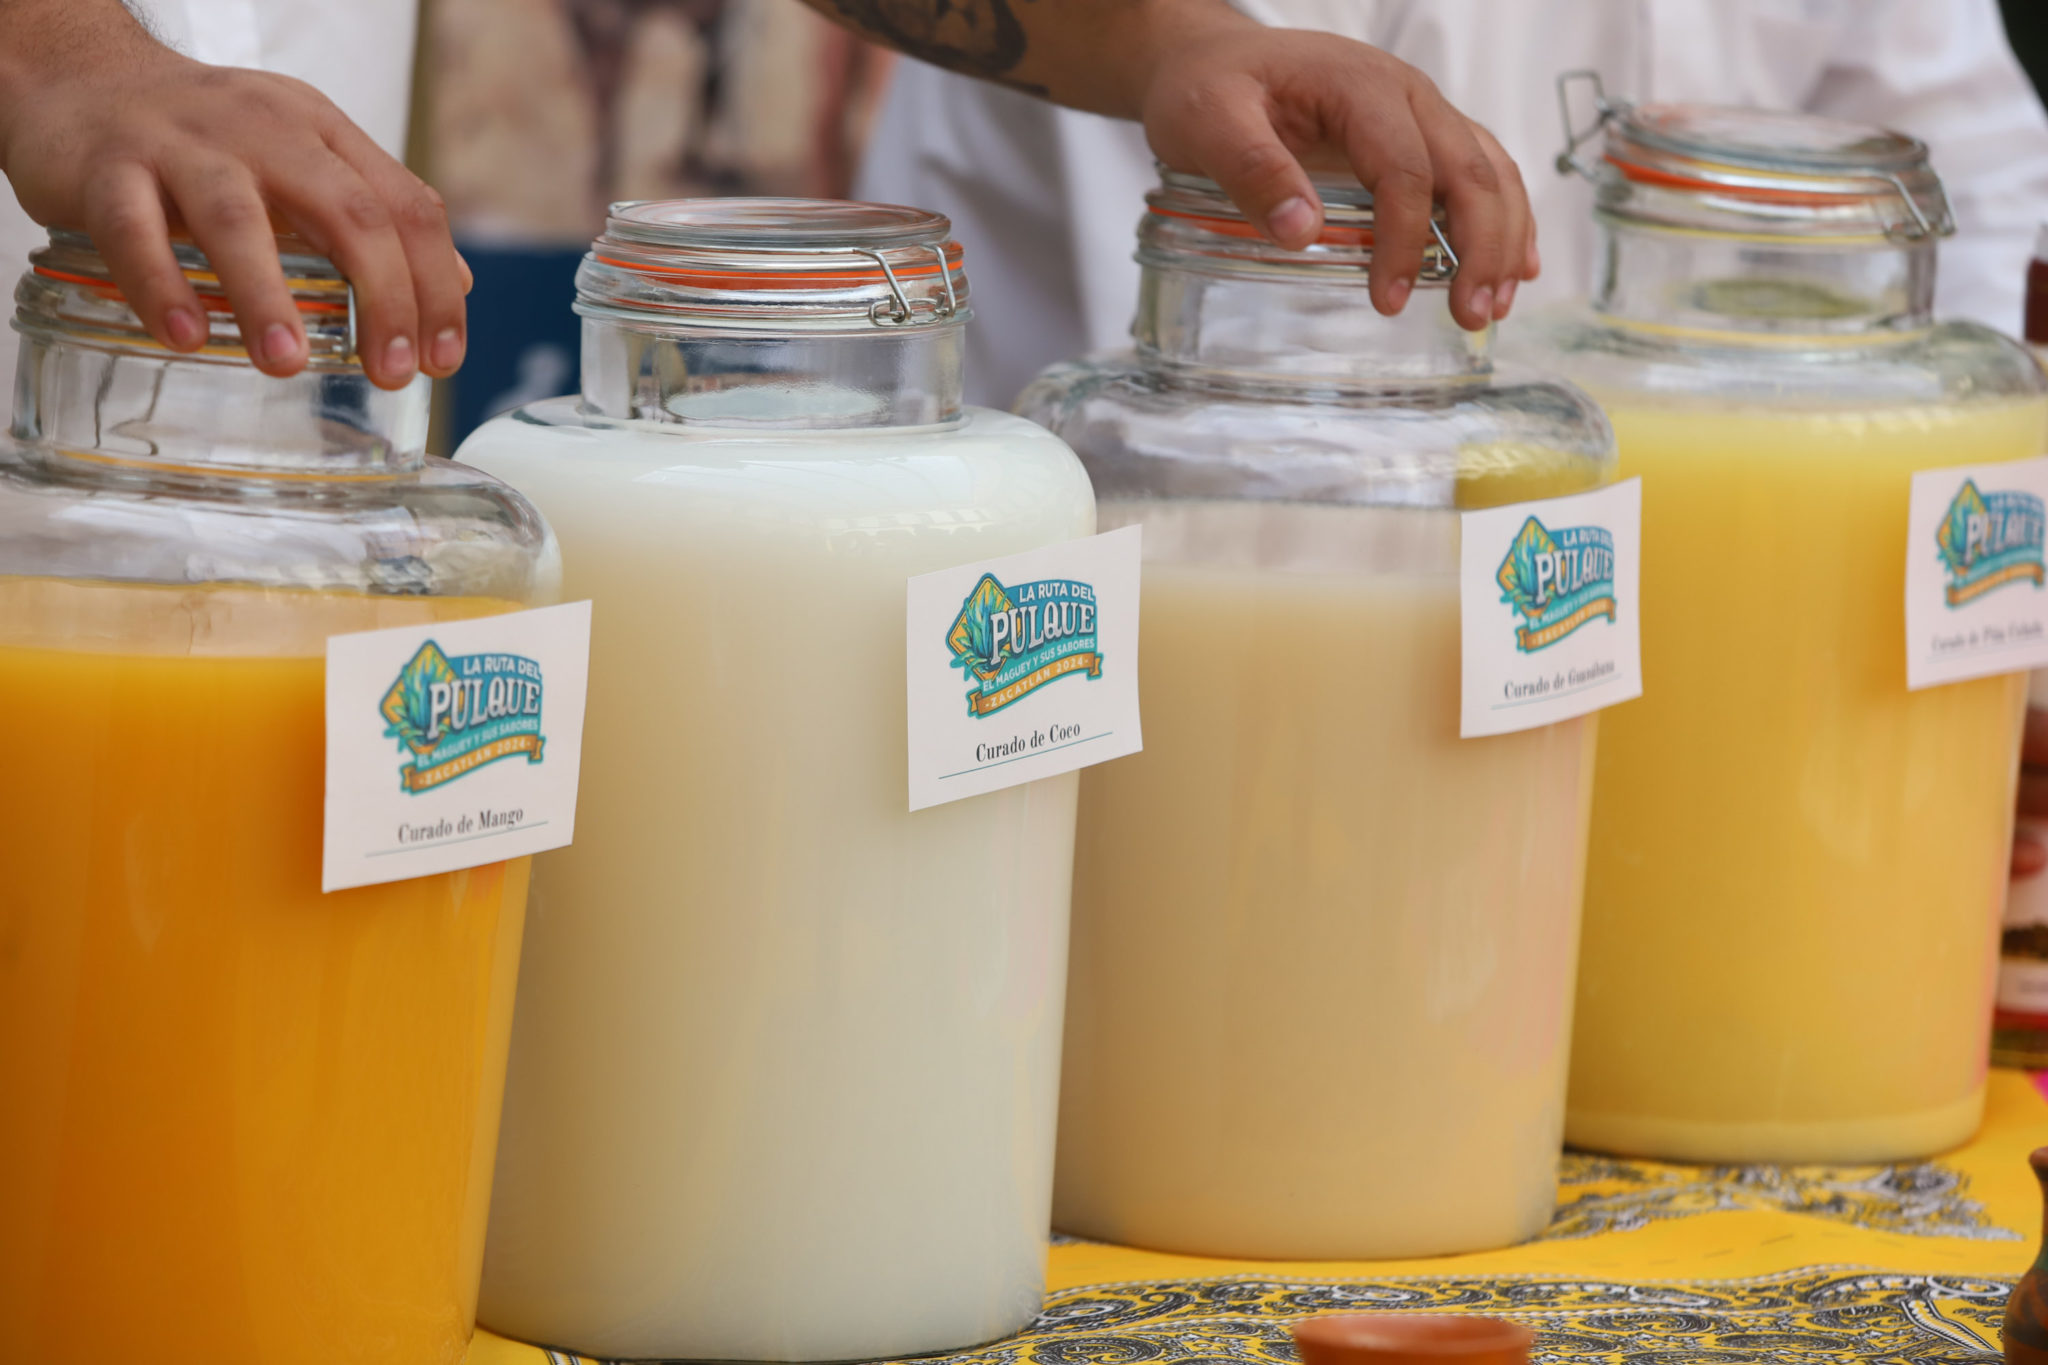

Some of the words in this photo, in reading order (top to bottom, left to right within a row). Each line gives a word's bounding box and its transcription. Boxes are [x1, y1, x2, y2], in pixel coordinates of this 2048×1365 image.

[1563, 530, 1578, 547] LA
[1019, 585, 1035, 603] LA
[1038, 583, 1068, 599] RUTA
[1071, 584, 1094, 602] DEL
[1535, 546, 1613, 605] PULQUE
[990, 601, 1094, 665] PULQUE
[463, 657, 482, 675] LA
[484, 656, 516, 673] RUTA
[518, 661, 541, 680] DEL
[982, 680, 994, 692] EL
[996, 662, 1031, 686] MAGUEY
[1032, 655, 1039, 667] Y
[1040, 648, 1056, 663] SUS
[1057, 638, 1095, 656] SABORES
[1504, 676, 1551, 699] Curado
[1553, 672, 1566, 690] de
[427, 676, 541, 740] PULQUE
[976, 735, 1026, 762] Curado
[1030, 729, 1045, 749] de
[1049, 723, 1081, 743] Coco
[398, 817, 453, 844] Curado
[457, 814, 474, 834] de
[478, 809, 524, 831] Mango
